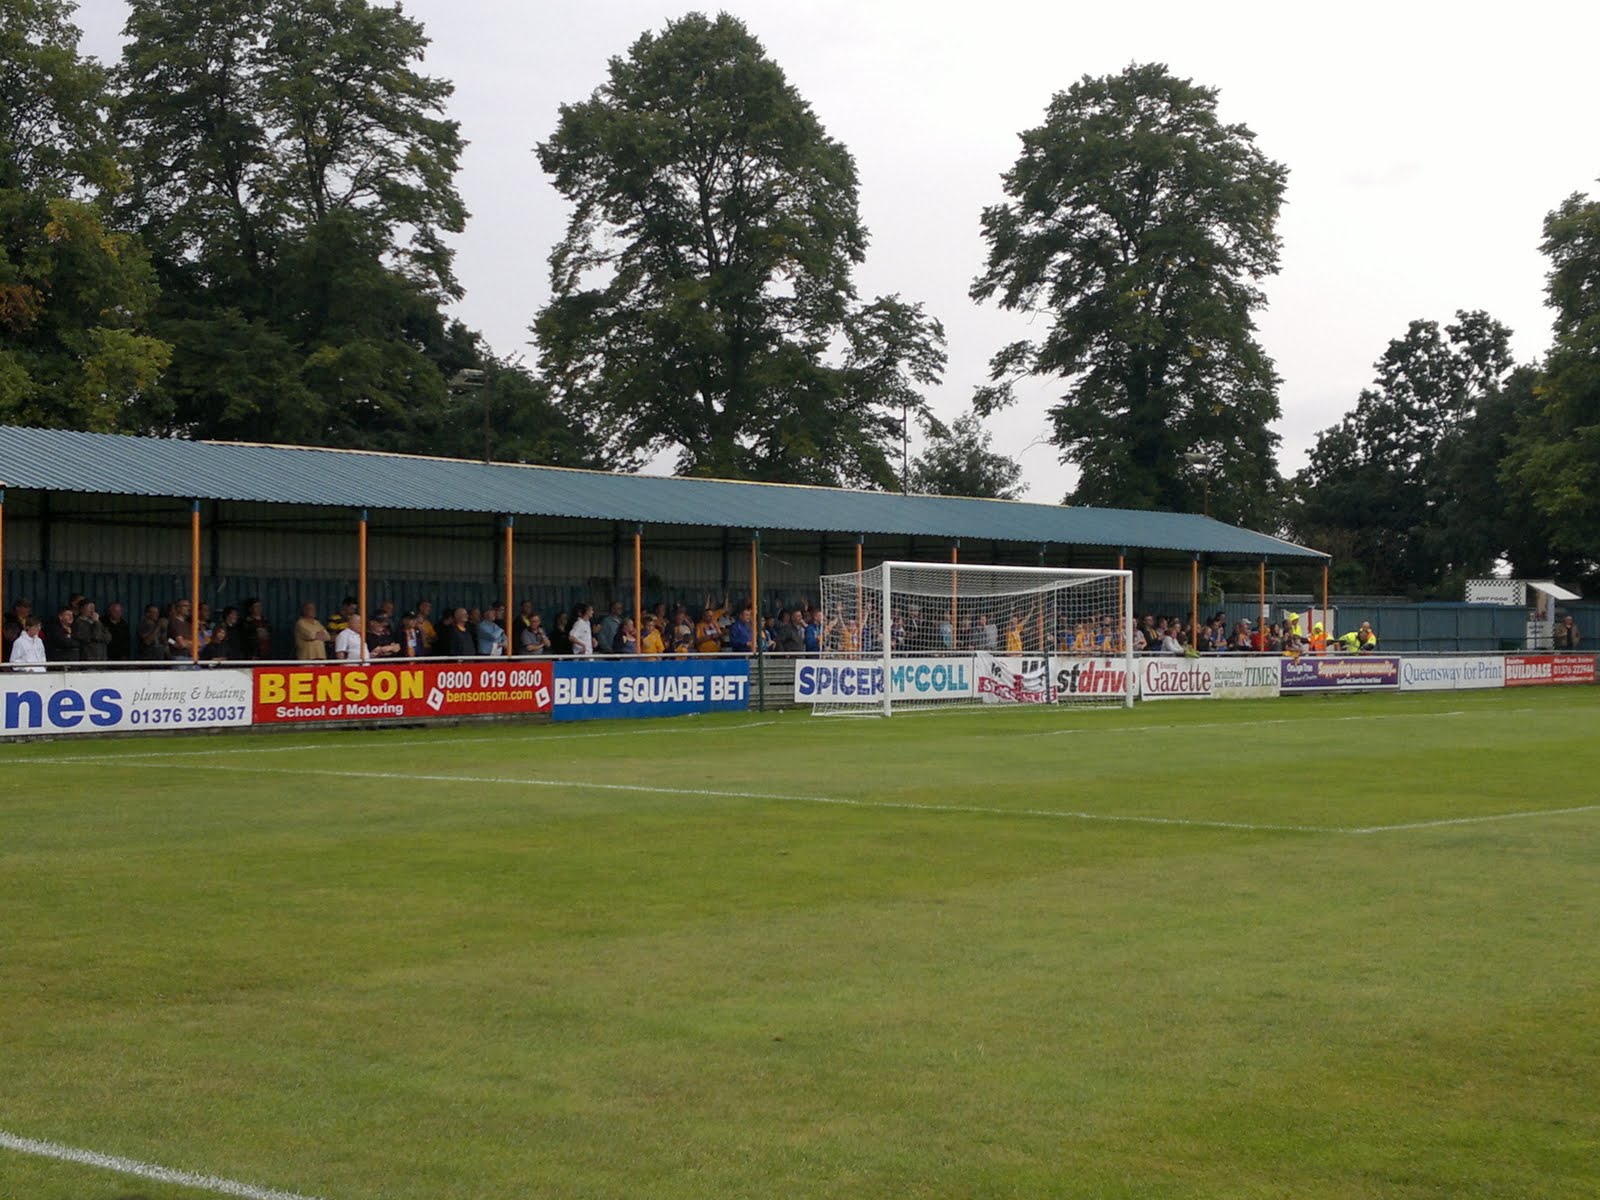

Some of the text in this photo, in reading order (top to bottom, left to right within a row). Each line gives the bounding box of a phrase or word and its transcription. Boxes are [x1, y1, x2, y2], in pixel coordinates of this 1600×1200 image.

[437, 669, 542, 690] 0800 019 0800
[799, 665, 885, 696] SPICER
[1146, 661, 1211, 692] Gazette
[1214, 666, 1243, 680] Braintree
[1244, 666, 1278, 688] TIMES
[1403, 662, 1462, 685] Queensway
[1463, 662, 1478, 680] for
[1478, 660, 1502, 679] Print
[1506, 663, 1552, 680] BUILDBASE
[132, 685, 246, 705] plumbing & heating
[259, 670, 424, 703] BENSON
[446, 689, 533, 703] bensonsom.com
[554, 674, 749, 706] BLUE SQUARE BET
[4, 687, 124, 729] nes
[130, 706, 246, 724] 01376 323037
[275, 702, 404, 718] School of Motoring
